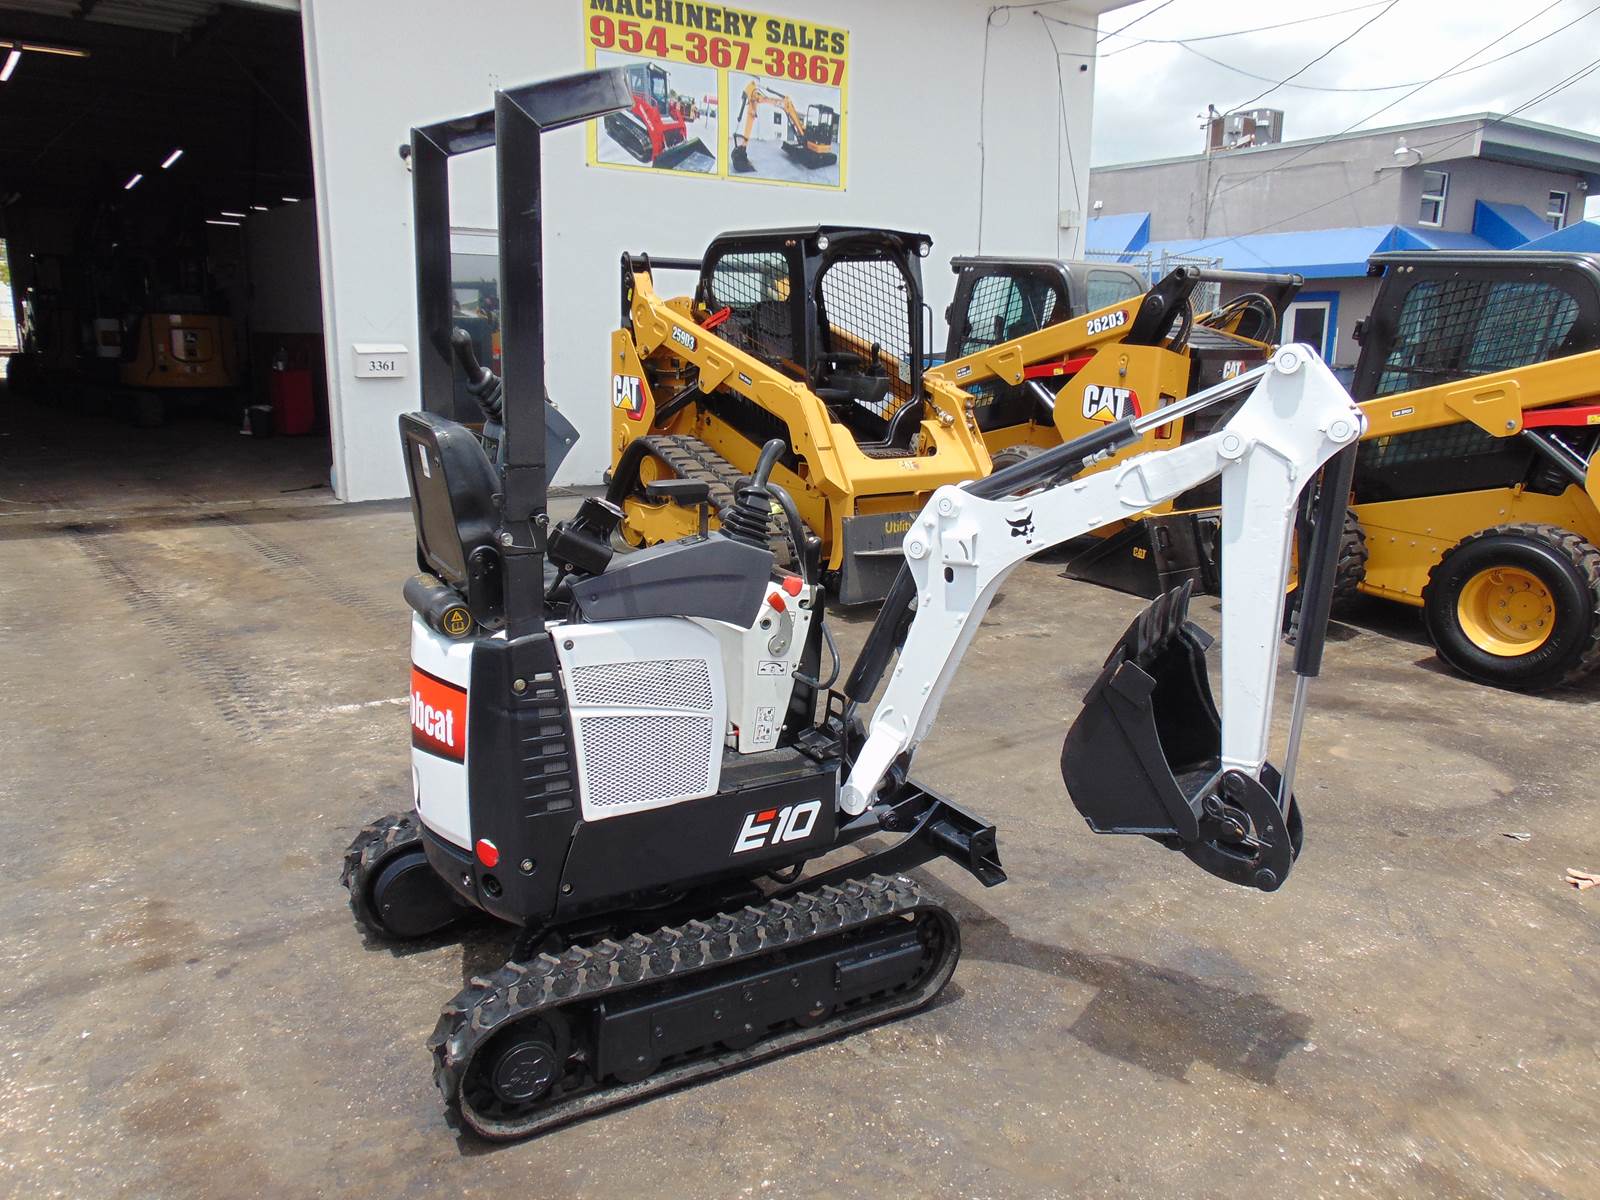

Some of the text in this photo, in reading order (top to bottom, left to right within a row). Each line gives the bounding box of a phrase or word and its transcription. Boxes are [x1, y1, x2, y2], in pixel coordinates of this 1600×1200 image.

[590, 0, 844, 54] MACHINERY SALES
[590, 15, 845, 86] 954-367-3867
[672, 325, 696, 351] 259D3
[1087, 313, 1126, 336] 262D3
[369, 360, 396, 371] 3361
[1222, 360, 1241, 380] CAT
[612, 374, 639, 409] CAT
[1082, 384, 1130, 422] CAT
[1132, 546, 1147, 559] CAT
[732, 799, 822, 854] E10
